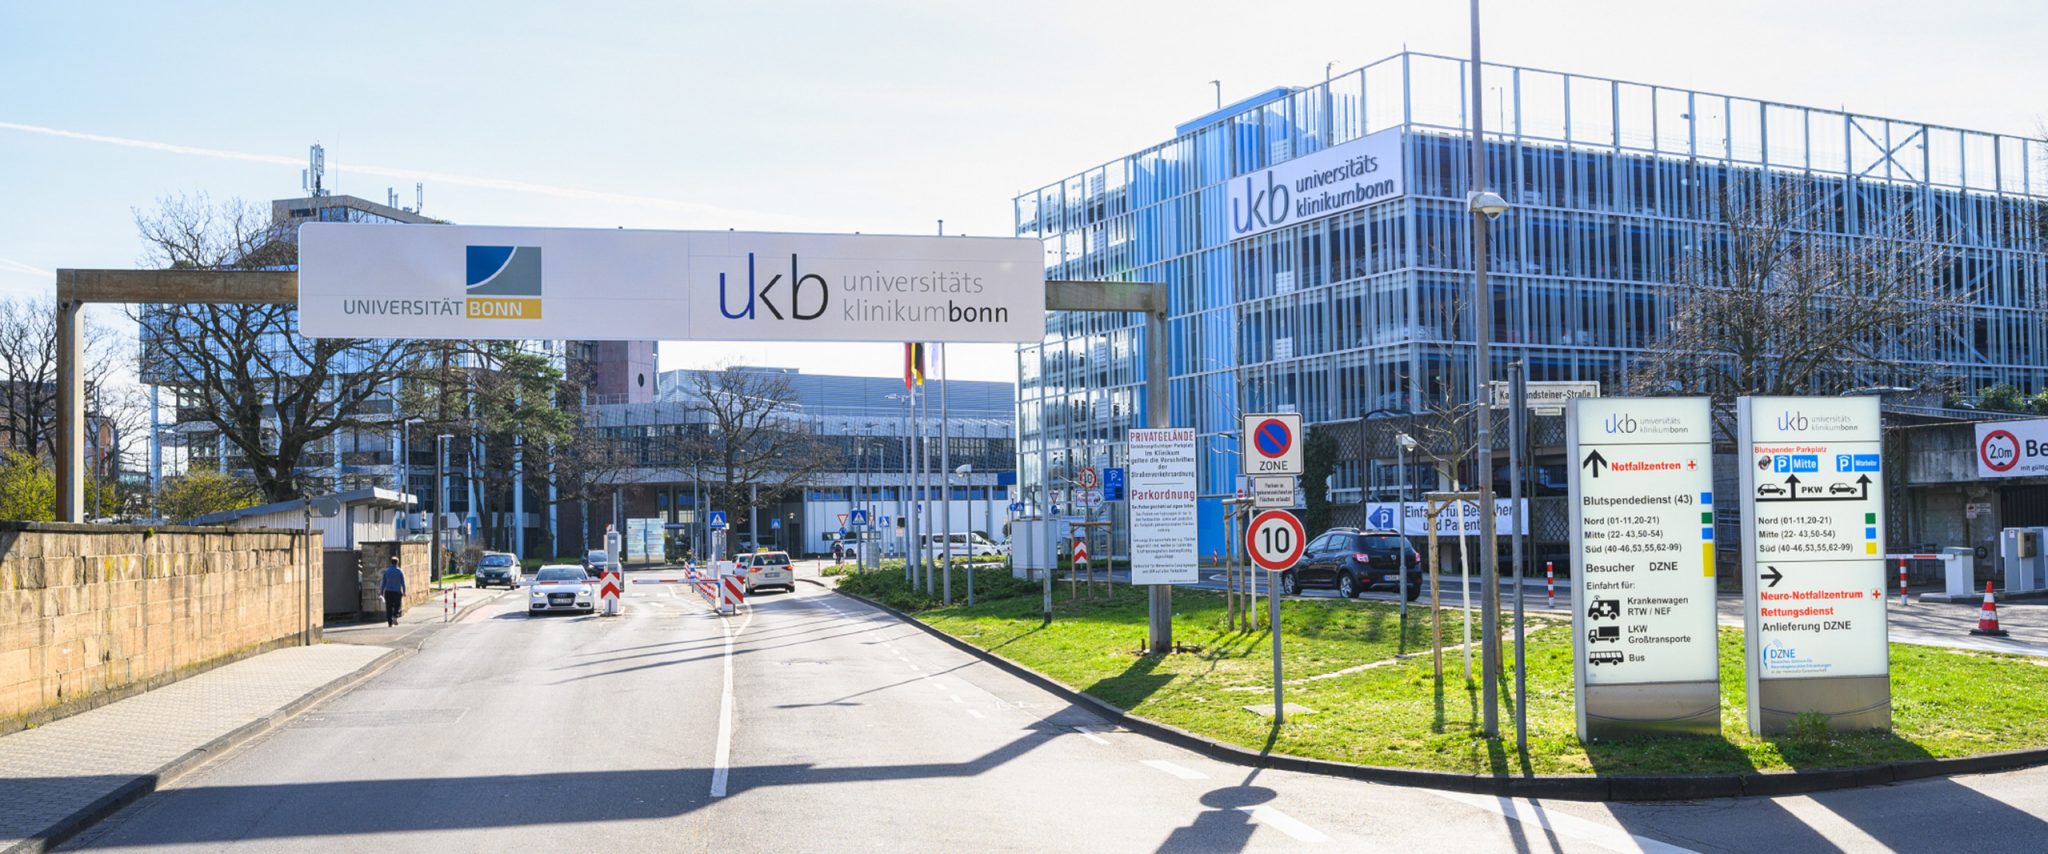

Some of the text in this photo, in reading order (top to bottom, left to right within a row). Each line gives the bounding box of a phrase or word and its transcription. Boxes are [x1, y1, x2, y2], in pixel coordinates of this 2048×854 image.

[1296, 154, 1378, 193] universitäts
[1233, 170, 1290, 234] ukb
[1296, 178, 1394, 218] klinikumbonn
[719, 252, 829, 321] ukb
[843, 270, 984, 294] universitäts
[343, 297, 522, 317] UNIVERSITÄT BONN
[843, 299, 1008, 323] klinikumbonn
[1500, 389, 1591, 400] Kaandsteiner-Straße
[1605, 413, 1637, 434] ukb
[1640, 417, 1681, 425] universitäts
[1777, 411, 1808, 431] ukb
[1812, 415, 1851, 423] universitäts
[1640, 426, 1688, 434] klinikumbonn
[1130, 430, 1194, 442] PRIVATGELÄNDE
[1754, 446, 1827, 455] Blutspender Parkplatz
[1259, 461, 1288, 471] ZONE
[1611, 461, 1681, 472] Notfallzentren
[1794, 459, 1816, 469] Mitte
[1801, 486, 1823, 494] PKW
[1131, 489, 1195, 502] Parkordnung
[1583, 494, 1693, 508] Blutspendedienst (43)
[1405, 506, 1443, 518] Einfa
[1463, 504, 1512, 517] Beher
[1423, 519, 1442, 531] ud
[1584, 516, 1660, 525] Nord (01-11,20-21)
[1759, 516, 1832, 525] Nord (01-11,20-21)
[1584, 531, 1605, 539] Mitte
[1759, 531, 1779, 539] Mitte
[1262, 527, 1290, 554] 10
[1585, 545, 1602, 553] Süd
[1760, 544, 1775, 553] Süd
[1586, 562, 1678, 573] Besucher DZNE
[1587, 581, 1636, 590] Einfahrt für:
[1760, 591, 1863, 601] Neuro-Notfallzentrum
[1627, 597, 1688, 606] Krankenwagen
[1628, 608, 1648, 616] RTW
[1655, 607, 1672, 615] NEF
[1761, 607, 1834, 618] Rettungsdienst
[1628, 625, 1648, 633] LKW
[1762, 621, 1852, 632] Anlieferung DZNE
[1628, 635, 1691, 645] Großtransporte
[1629, 654, 1645, 662] Bus
[1770, 649, 1796, 659] DZNE
